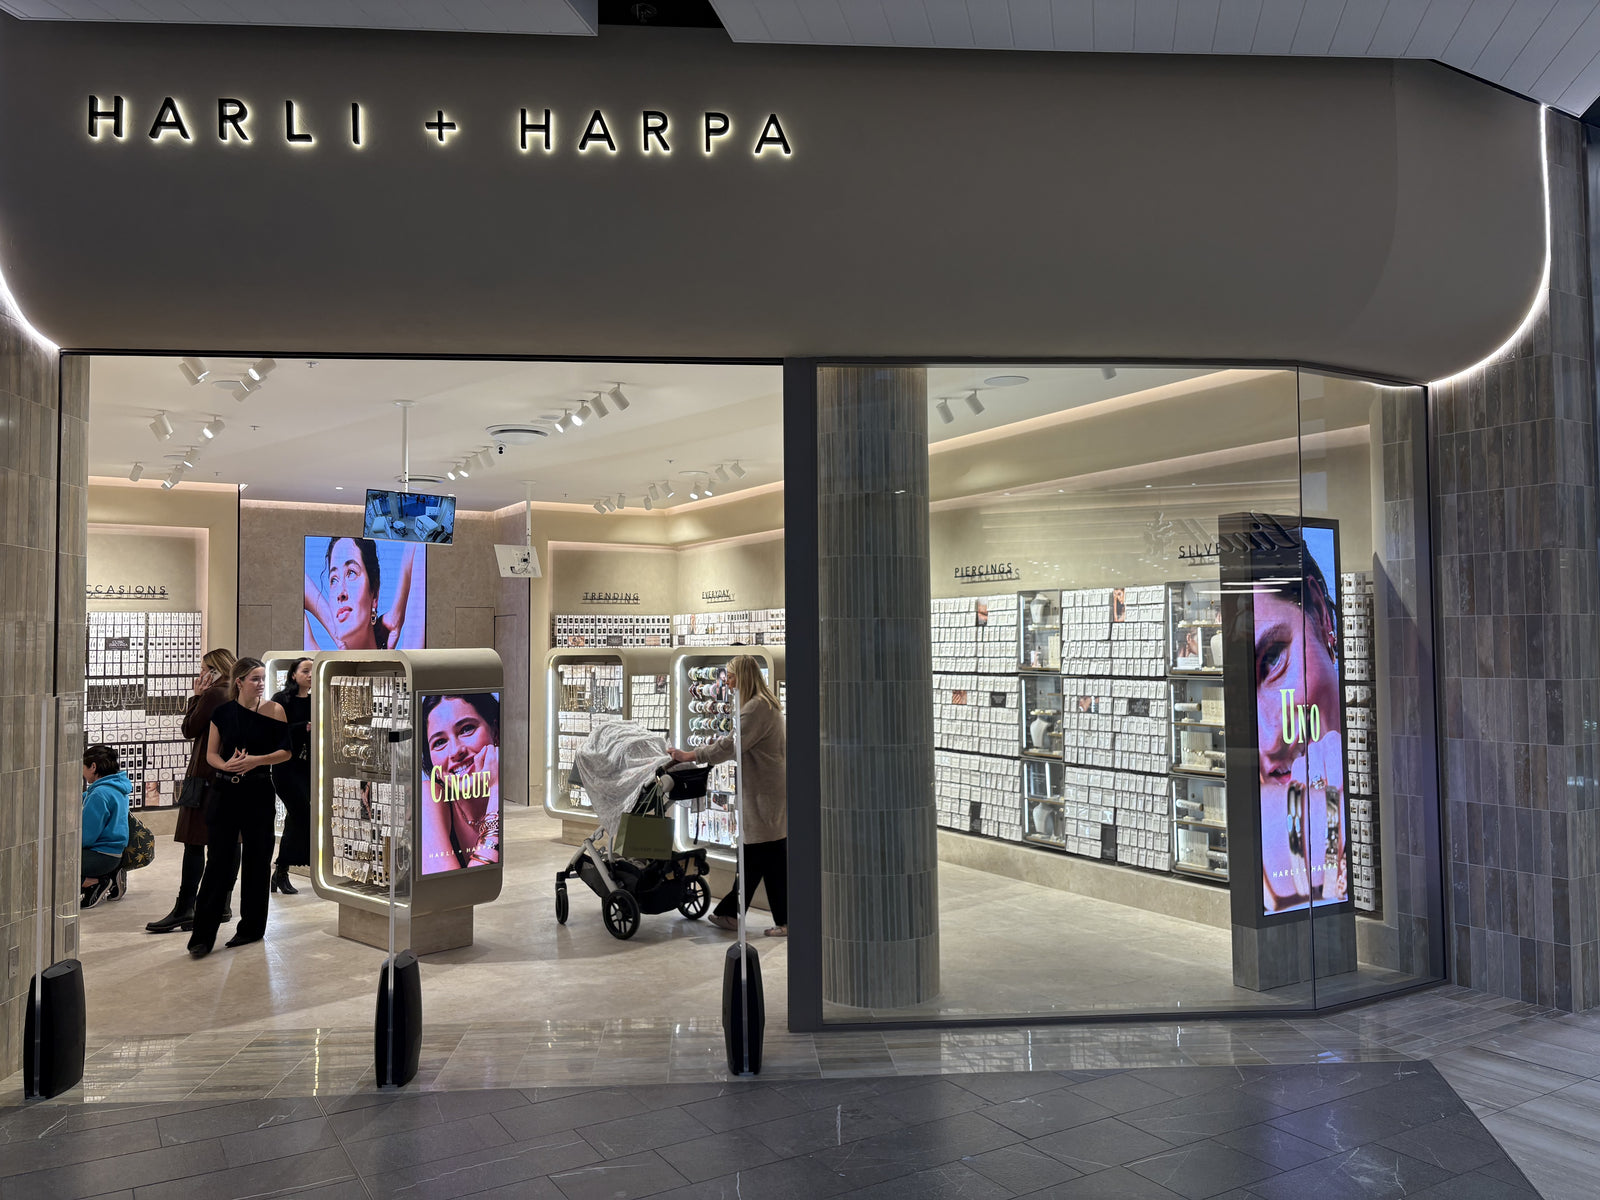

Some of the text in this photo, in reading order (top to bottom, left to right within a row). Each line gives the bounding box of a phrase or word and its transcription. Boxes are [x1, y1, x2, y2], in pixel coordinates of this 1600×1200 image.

[87, 94, 792, 156] HARLI + HARPA
[954, 562, 1012, 577] PIERCINGS
[86, 585, 166, 594] CCASIONS
[702, 589, 730, 599] EVERYDAY
[583, 592, 640, 600] TRENDING
[431, 766, 490, 802] CINQUE
[429, 849, 455, 858] HARLI
[1273, 869, 1299, 878] HARLI
[1311, 862, 1338, 872] HARPA
